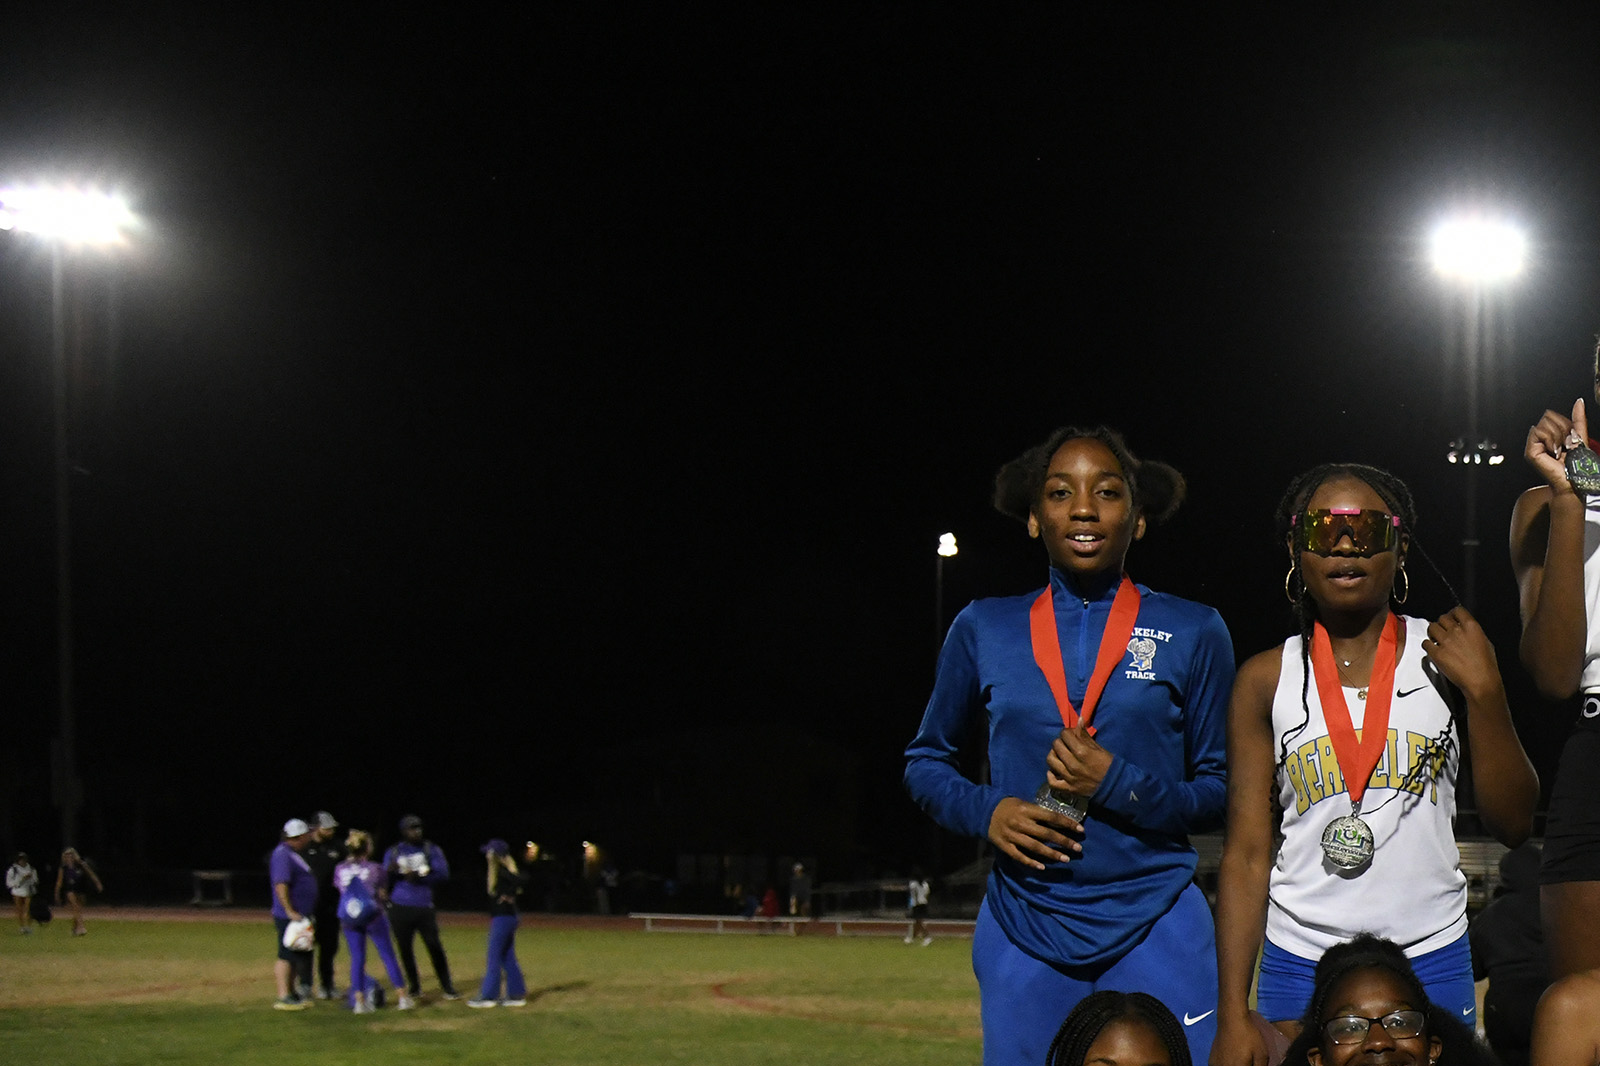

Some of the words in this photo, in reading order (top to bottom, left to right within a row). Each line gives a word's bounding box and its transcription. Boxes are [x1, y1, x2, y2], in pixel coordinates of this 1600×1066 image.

[1131, 627, 1173, 643] KELEY
[1125, 670, 1156, 681] TRACK
[1285, 727, 1447, 817] BERLEY
